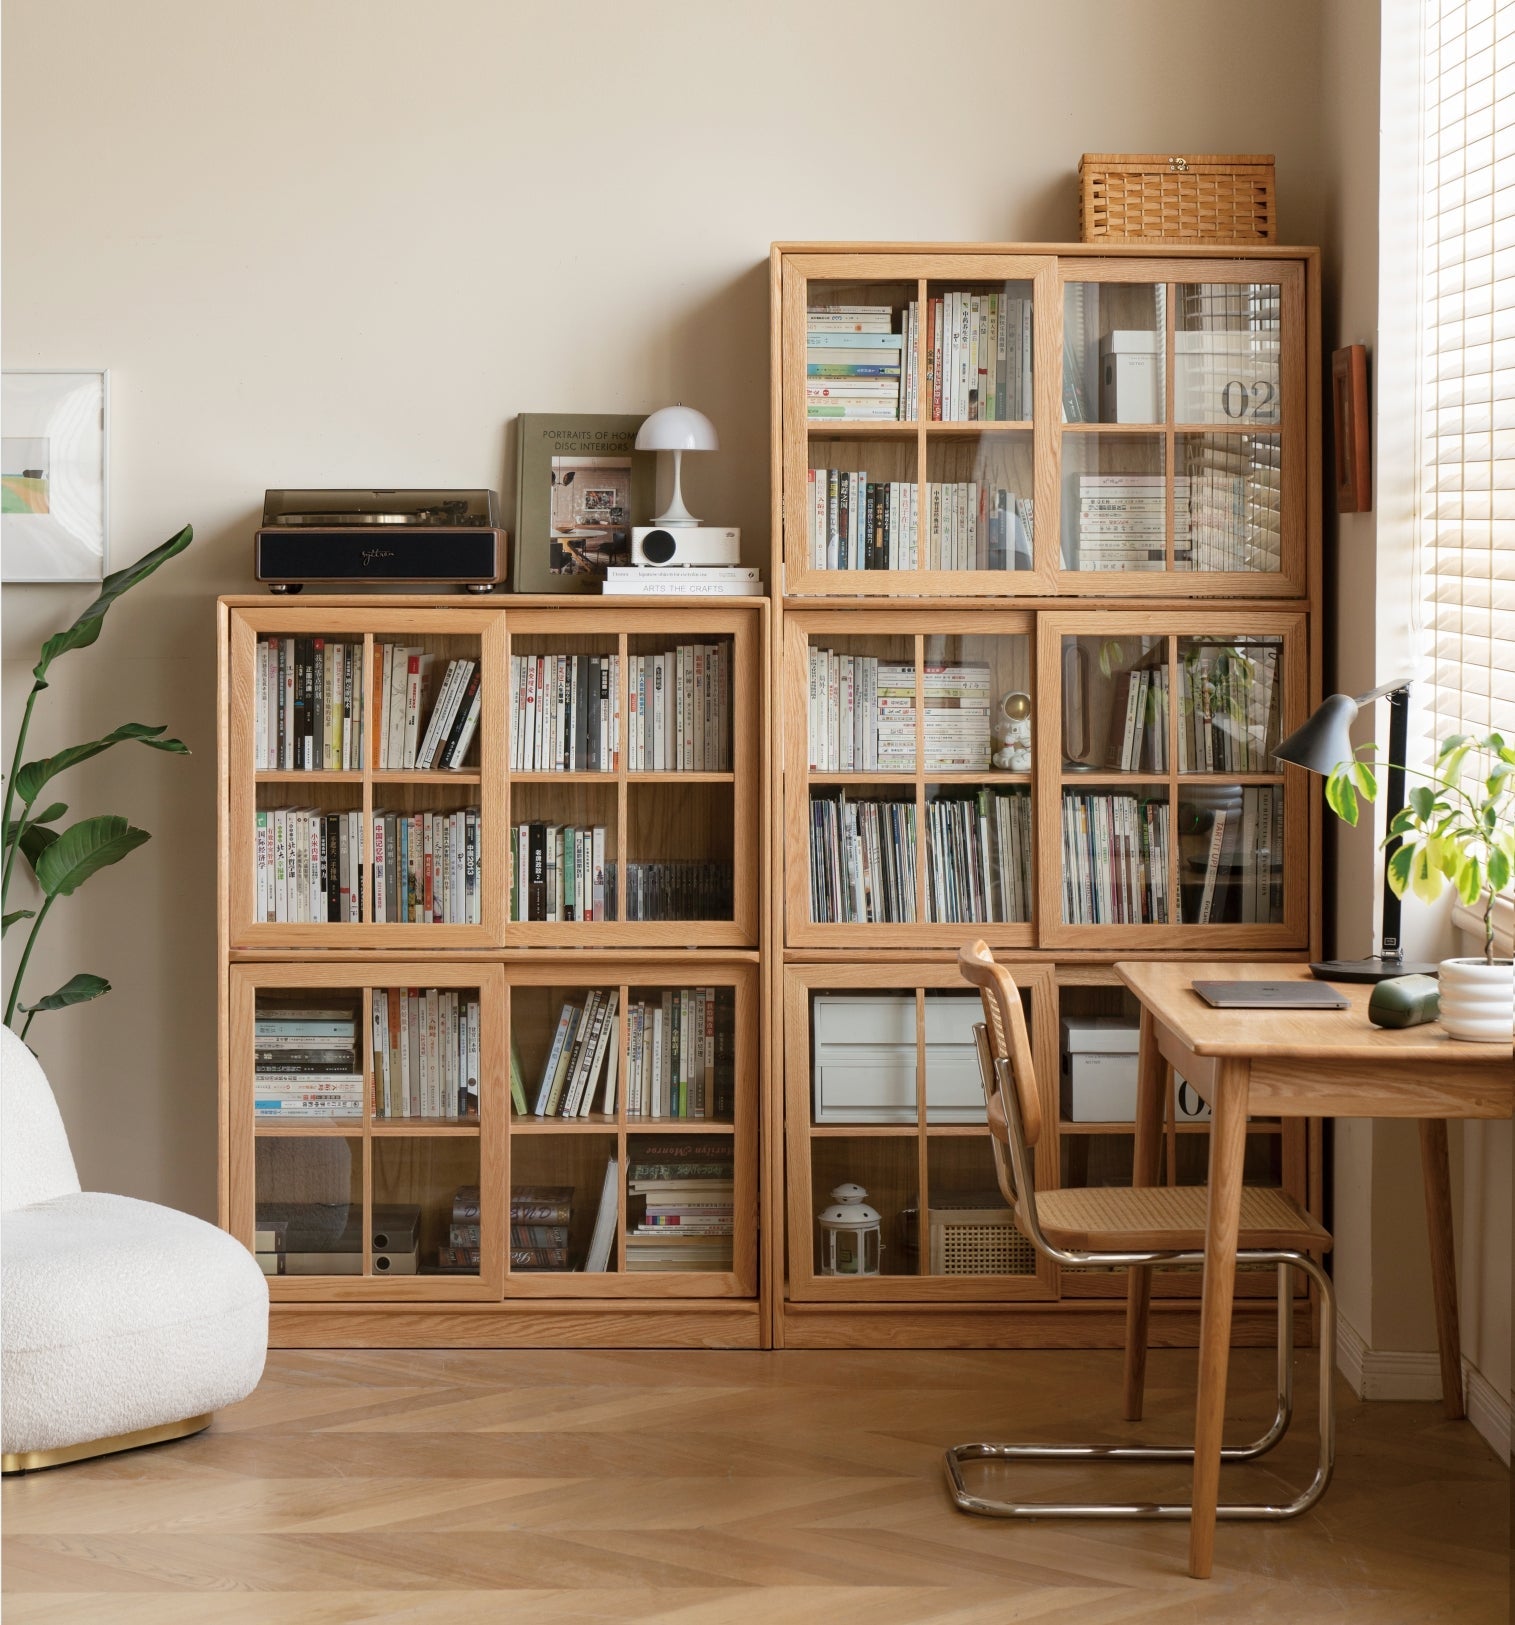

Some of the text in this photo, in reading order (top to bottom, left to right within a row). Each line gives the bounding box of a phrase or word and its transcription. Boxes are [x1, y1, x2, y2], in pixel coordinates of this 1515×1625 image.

[1222, 381, 1274, 418] 02
[543, 430, 638, 440] PORTRAITS OF HOM
[554, 442, 629, 451] DISC INTERIORS
[1210, 822, 1224, 868] TART IT UP!
[1178, 1080, 1212, 1117] 0
